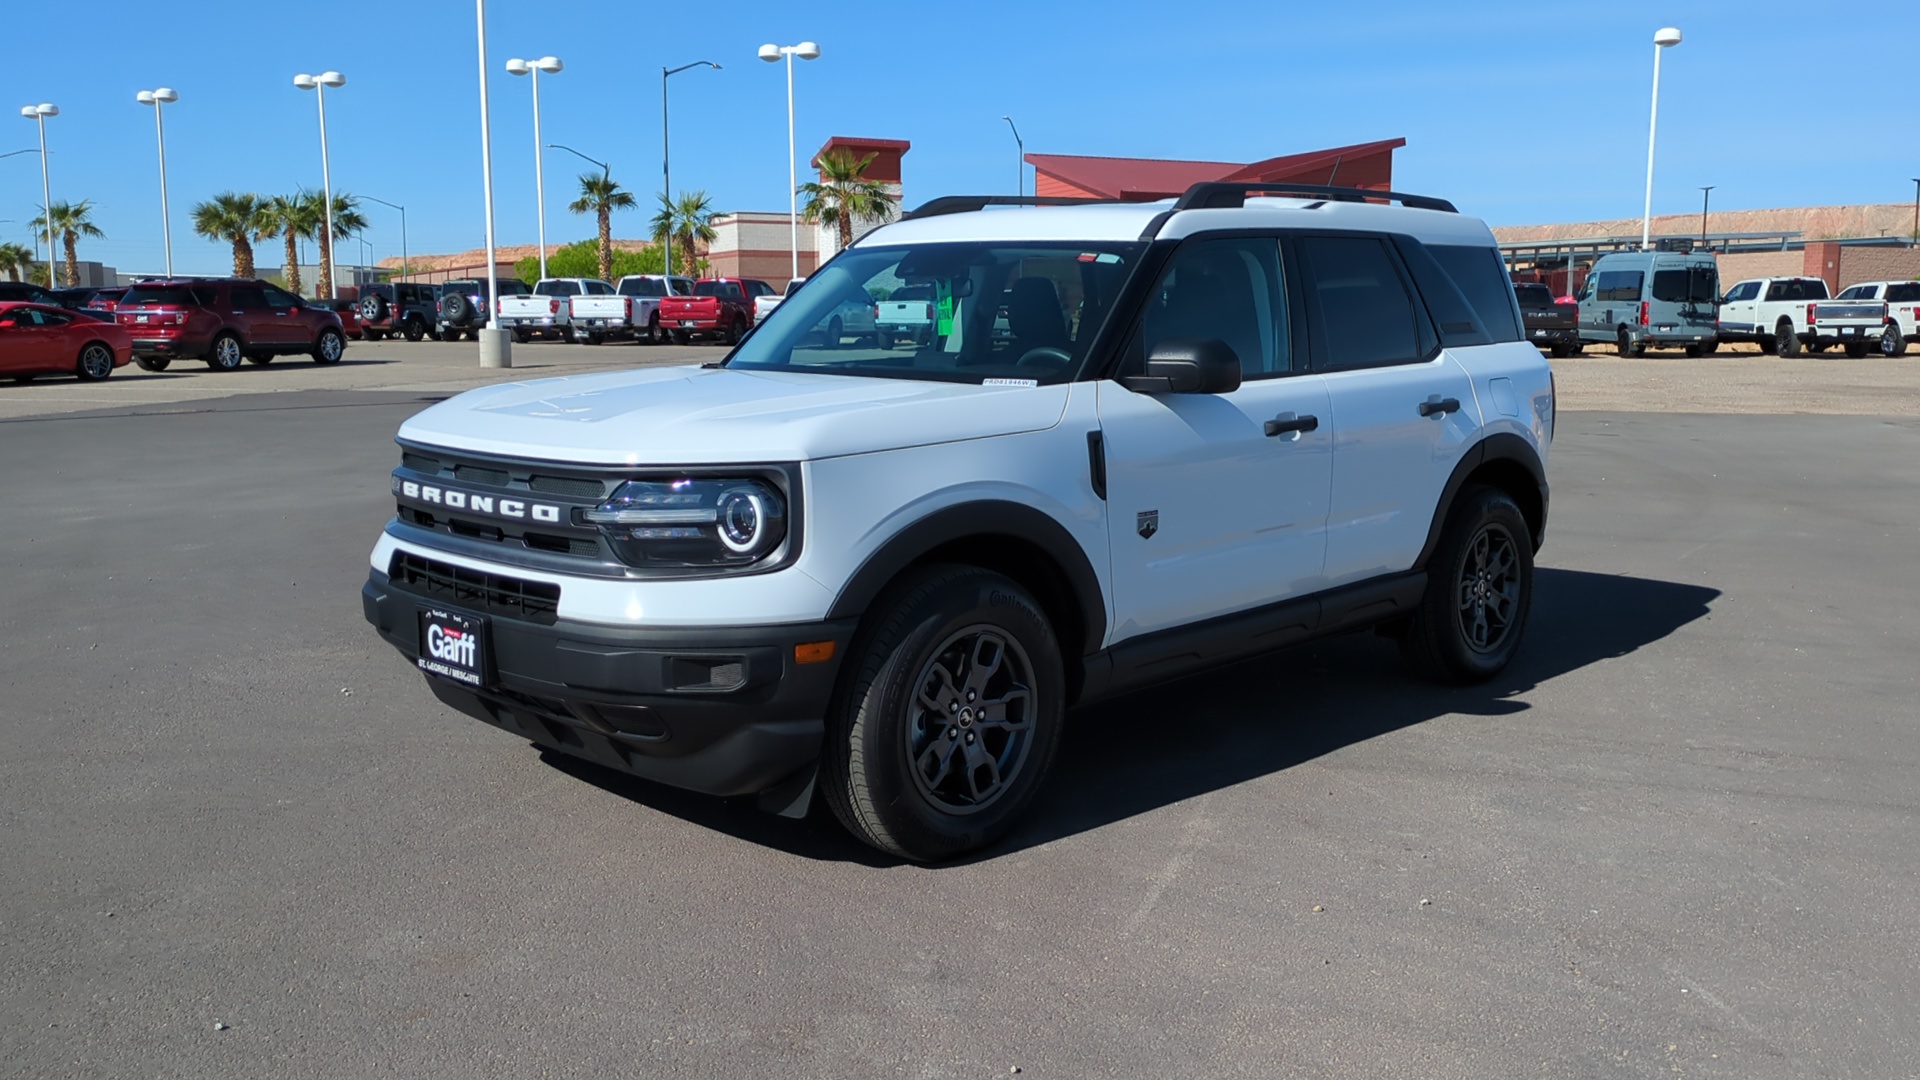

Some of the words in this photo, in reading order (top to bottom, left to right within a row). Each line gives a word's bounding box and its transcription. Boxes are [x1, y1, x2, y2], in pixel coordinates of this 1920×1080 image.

[403, 481, 560, 522] BRONCO
[989, 590, 1043, 632] Continental
[428, 624, 475, 667] Garff
[426, 660, 449, 675] GEORGE
[452, 669, 480, 685] MESQUITE
